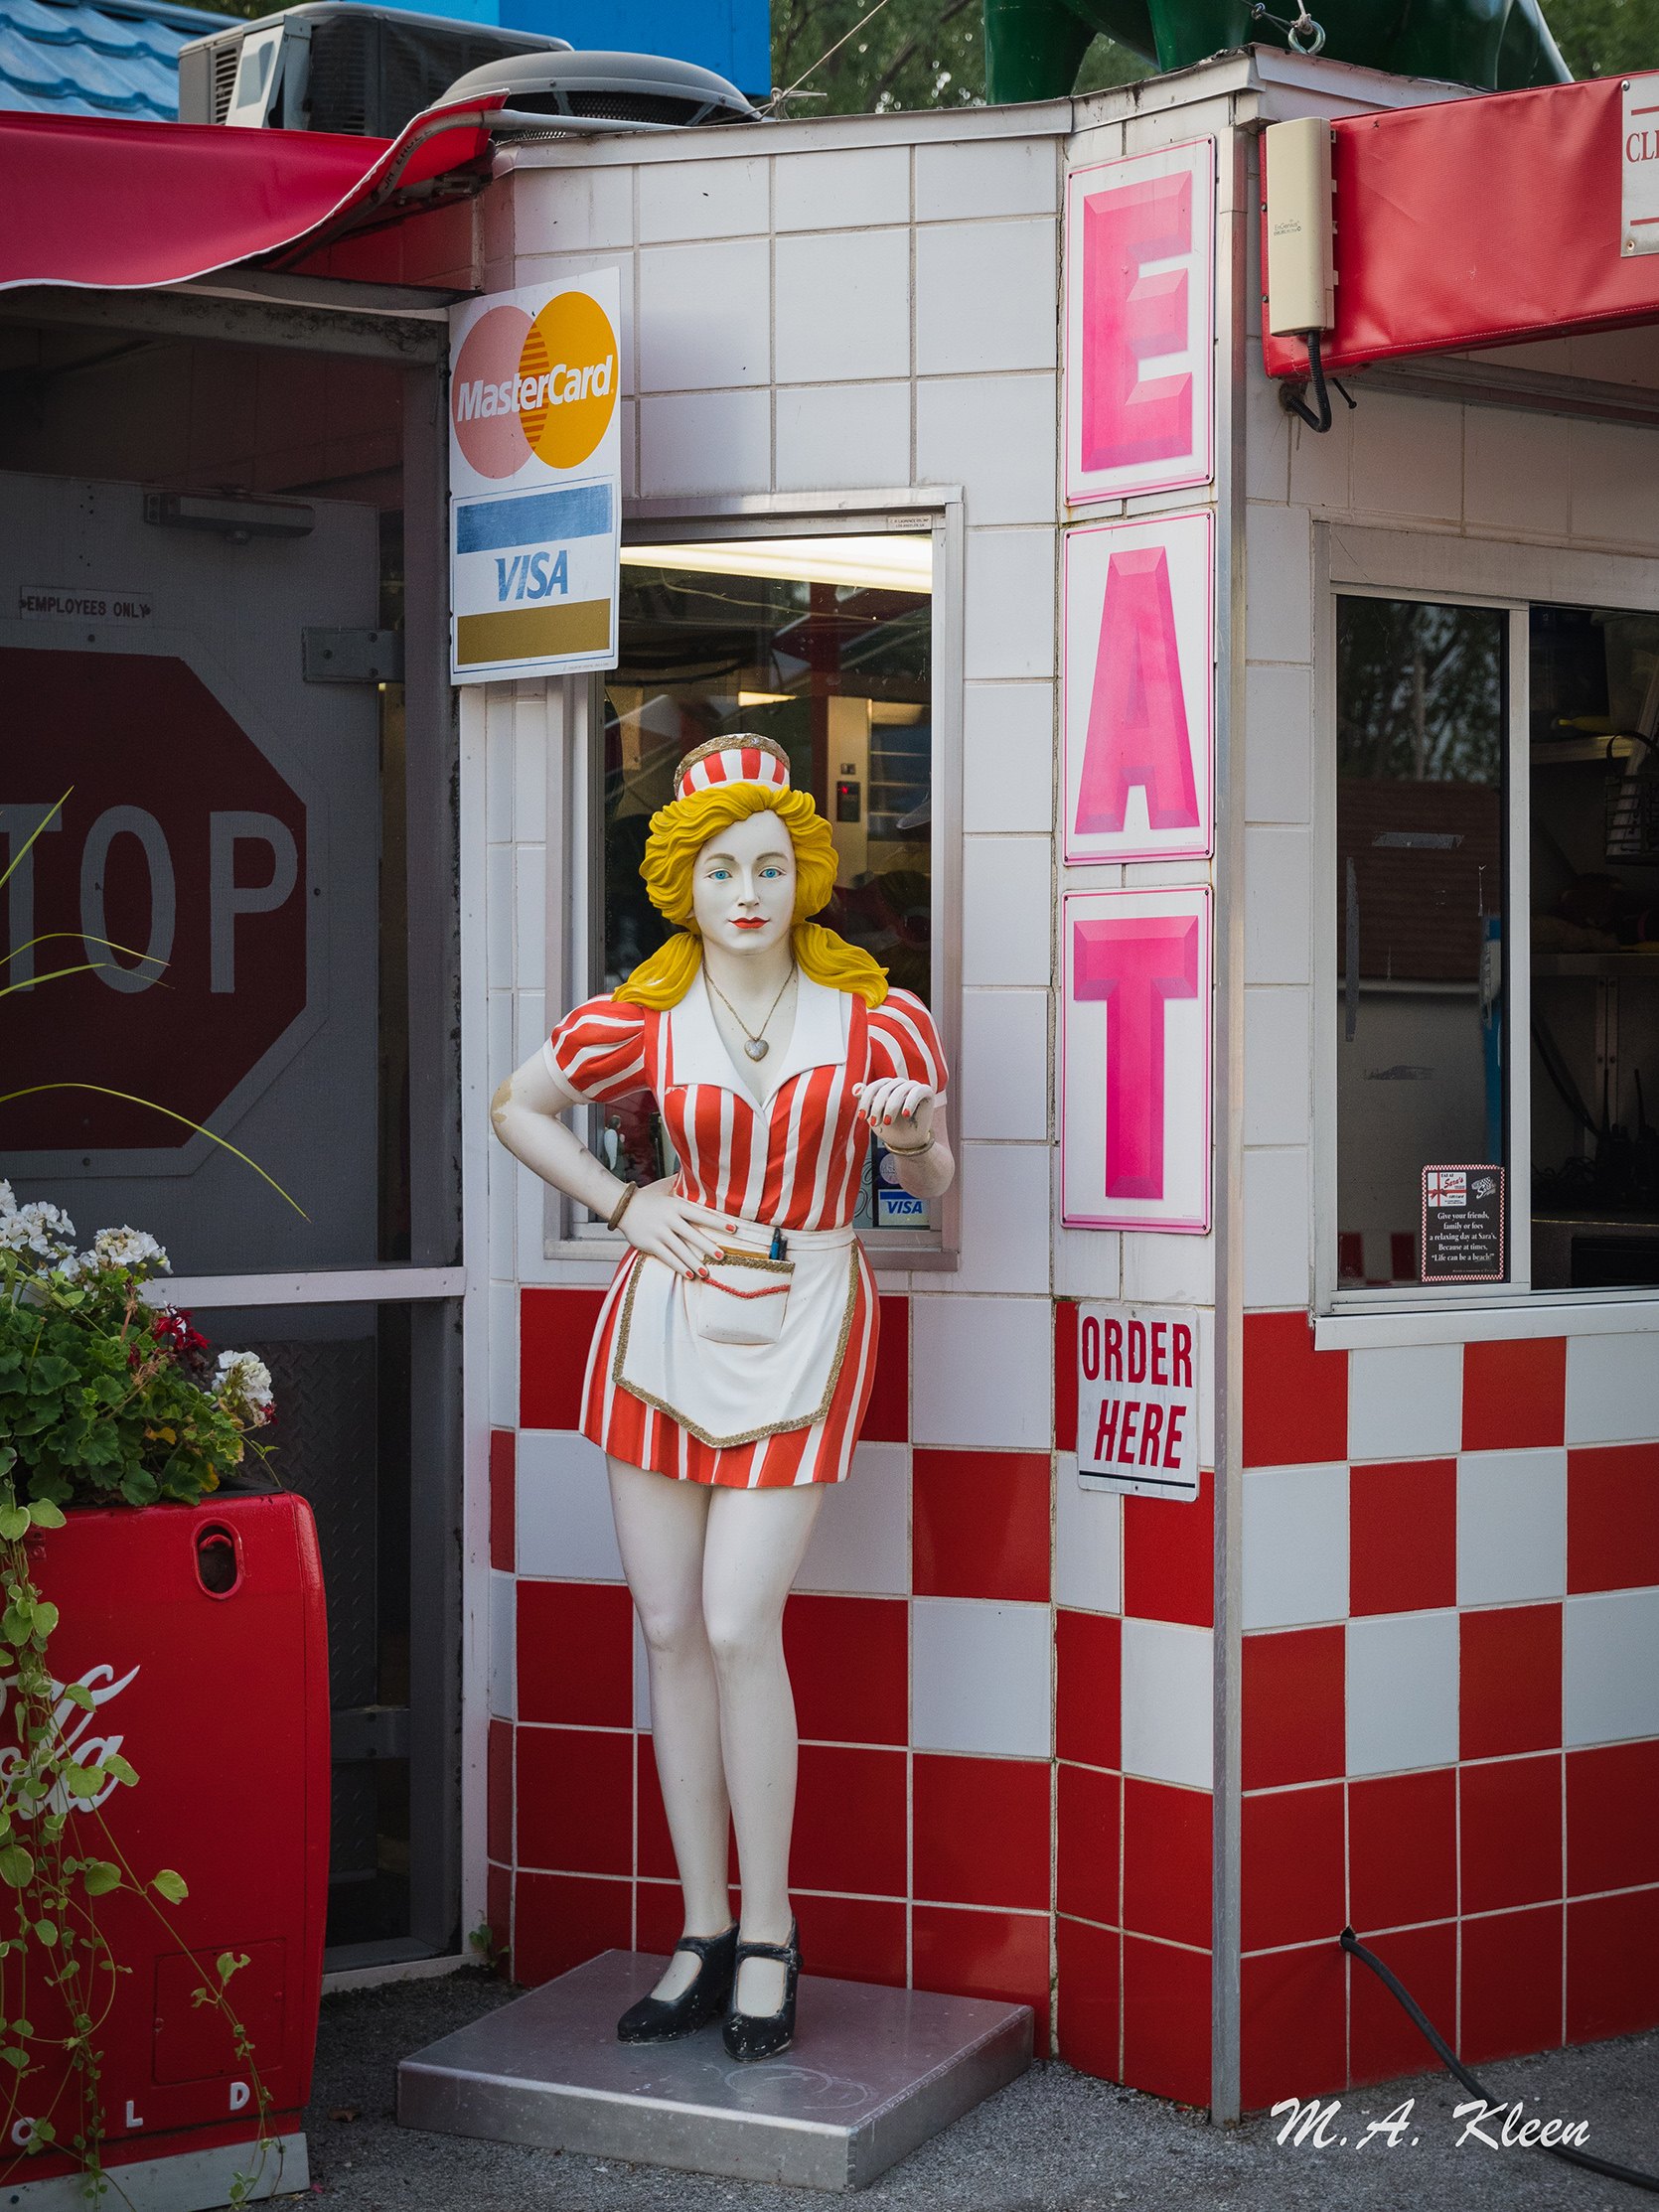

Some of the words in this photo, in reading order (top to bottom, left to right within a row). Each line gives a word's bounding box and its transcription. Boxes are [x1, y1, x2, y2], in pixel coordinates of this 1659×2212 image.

[456, 354, 614, 423] MasterCard
[494, 549, 569, 602] VISA
[27, 596, 106, 616] EMPLOYEES
[113, 601, 148, 618] ONLY
[886, 1200, 923, 1215] VISA
[1434, 1233, 1459, 1243] relaxing
[1459, 1232, 1470, 1242] day
[1443, 1222, 1462, 1232] family
[1082, 1316, 1193, 1389] ORDER
[1094, 1399, 1187, 1469] HERE
